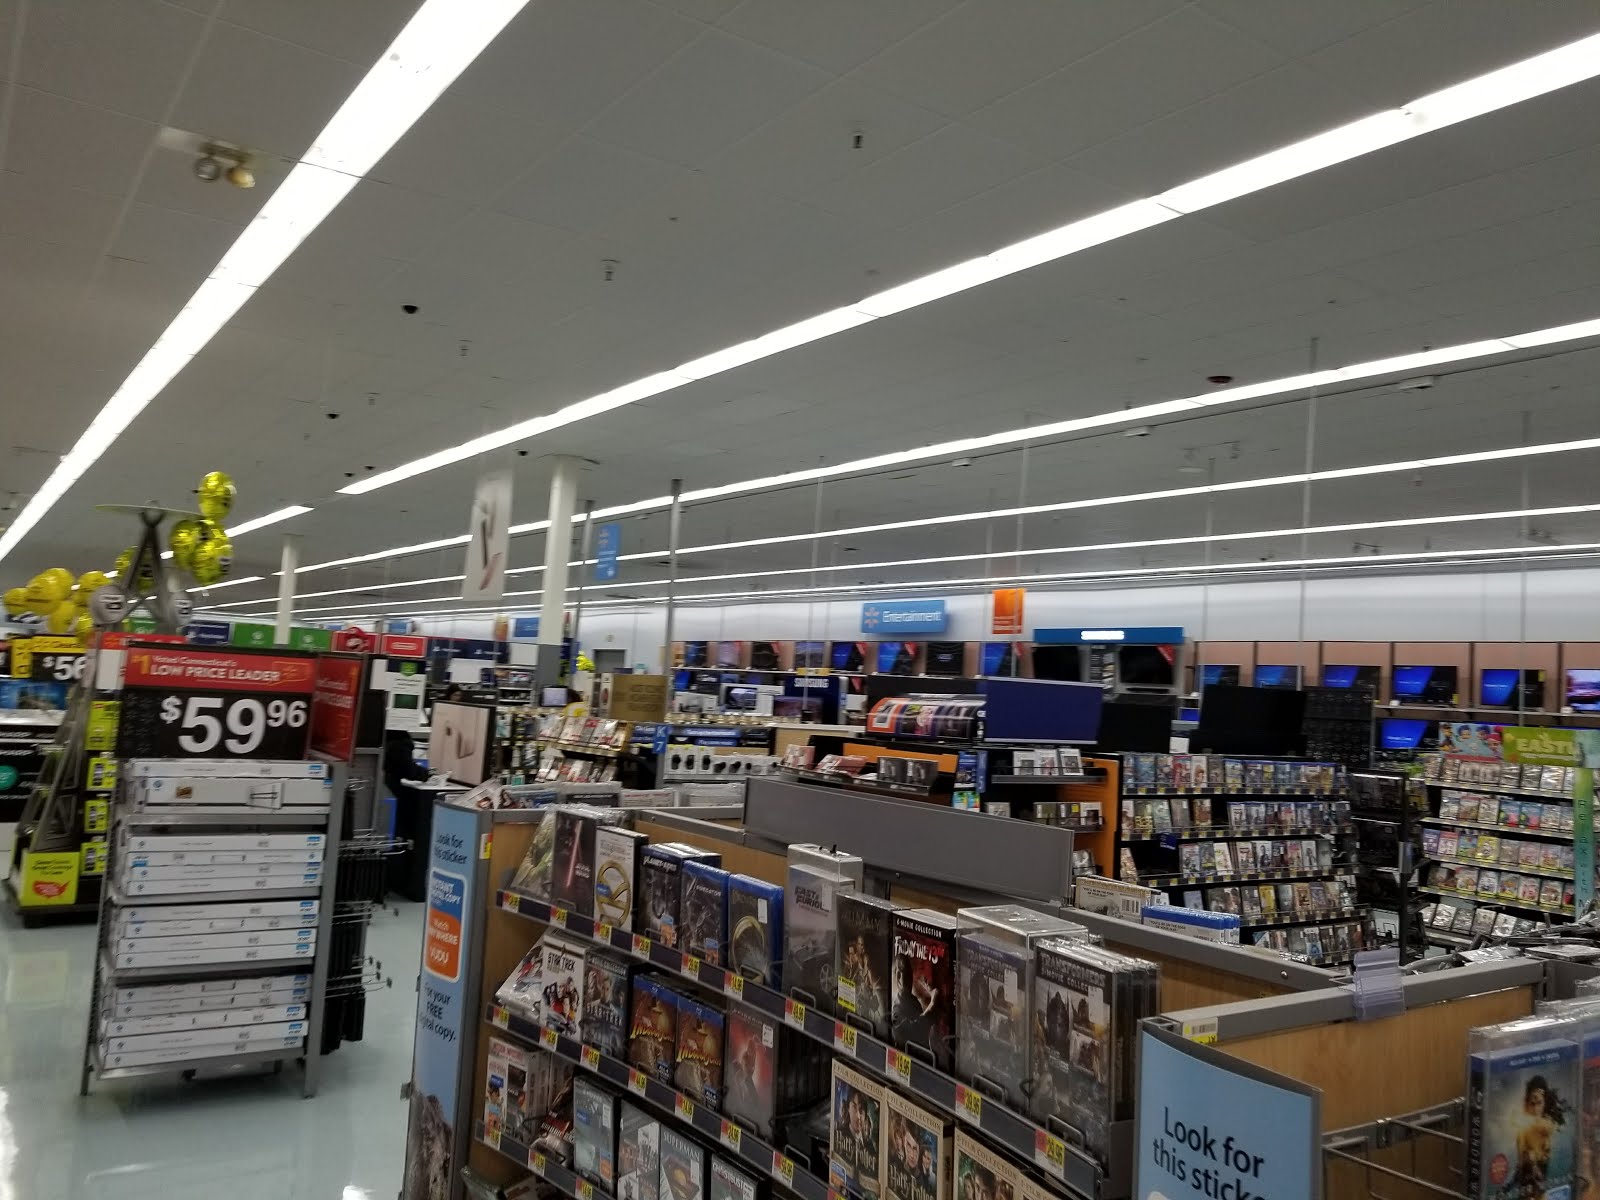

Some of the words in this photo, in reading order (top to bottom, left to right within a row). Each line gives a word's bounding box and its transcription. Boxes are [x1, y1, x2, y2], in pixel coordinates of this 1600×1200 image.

[882, 611, 942, 623] Entertainment
[150, 664, 183, 676] LOW
[185, 666, 226, 678] PRICE
[228, 669, 280, 681] LEADER
[795, 886, 815, 898] FAST
[915, 924, 942, 938] COLLECTION
[894, 936, 916, 958] FRIDAY
[1041, 952, 1106, 988] TRANSFORMERS
[426, 1001, 443, 1020] FREE
[904, 1105, 941, 1131] COLLECTION
[664, 1132, 700, 1161] SUPERMAN
[1164, 1106, 1217, 1161] Look
[1223, 1136, 1264, 1178] for
[975, 1146, 1017, 1180] COLLECTION
[1153, 1138, 1187, 1182] this
